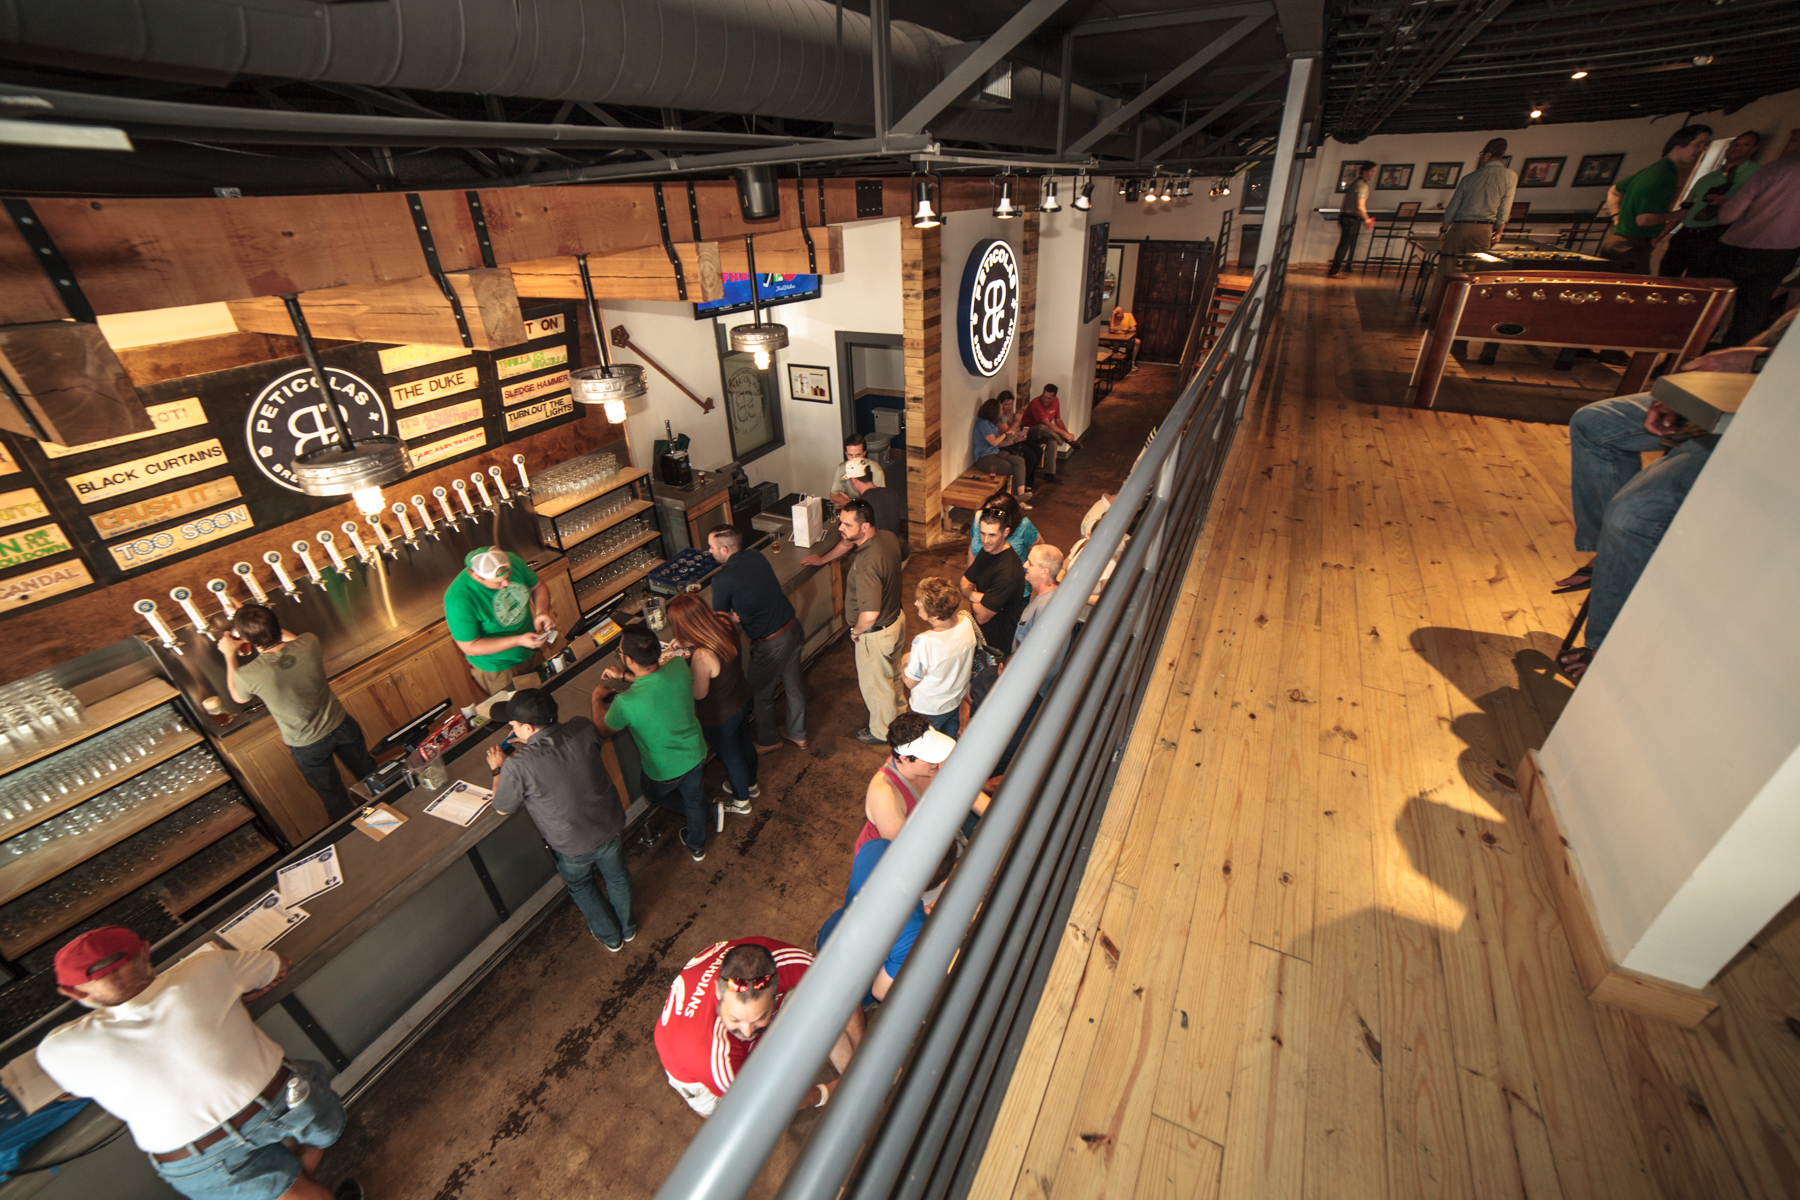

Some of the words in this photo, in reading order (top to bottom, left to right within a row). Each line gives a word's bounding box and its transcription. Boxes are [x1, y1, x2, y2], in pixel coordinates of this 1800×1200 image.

[541, 317, 558, 331] ON
[383, 345, 425, 366] GOOD
[394, 383, 424, 401] THE
[429, 372, 465, 392] DUKE
[504, 384, 535, 399] SLEDGE
[537, 374, 568, 390] HAMMER
[508, 409, 530, 422] TURN
[532, 403, 547, 414] OUT
[549, 398, 565, 408] THE
[545, 403, 572, 418] LIGHTS
[77, 469, 139, 495] BLACK
[145, 446, 223, 475] CURTAINS
[96, 494, 182, 530] CRUSH
[188, 486, 208, 504] IT
[24, 529, 49, 542] OR
[113, 532, 174, 560] TOO
[181, 507, 248, 540] SOON
[22, 543, 68, 561] DOWN
